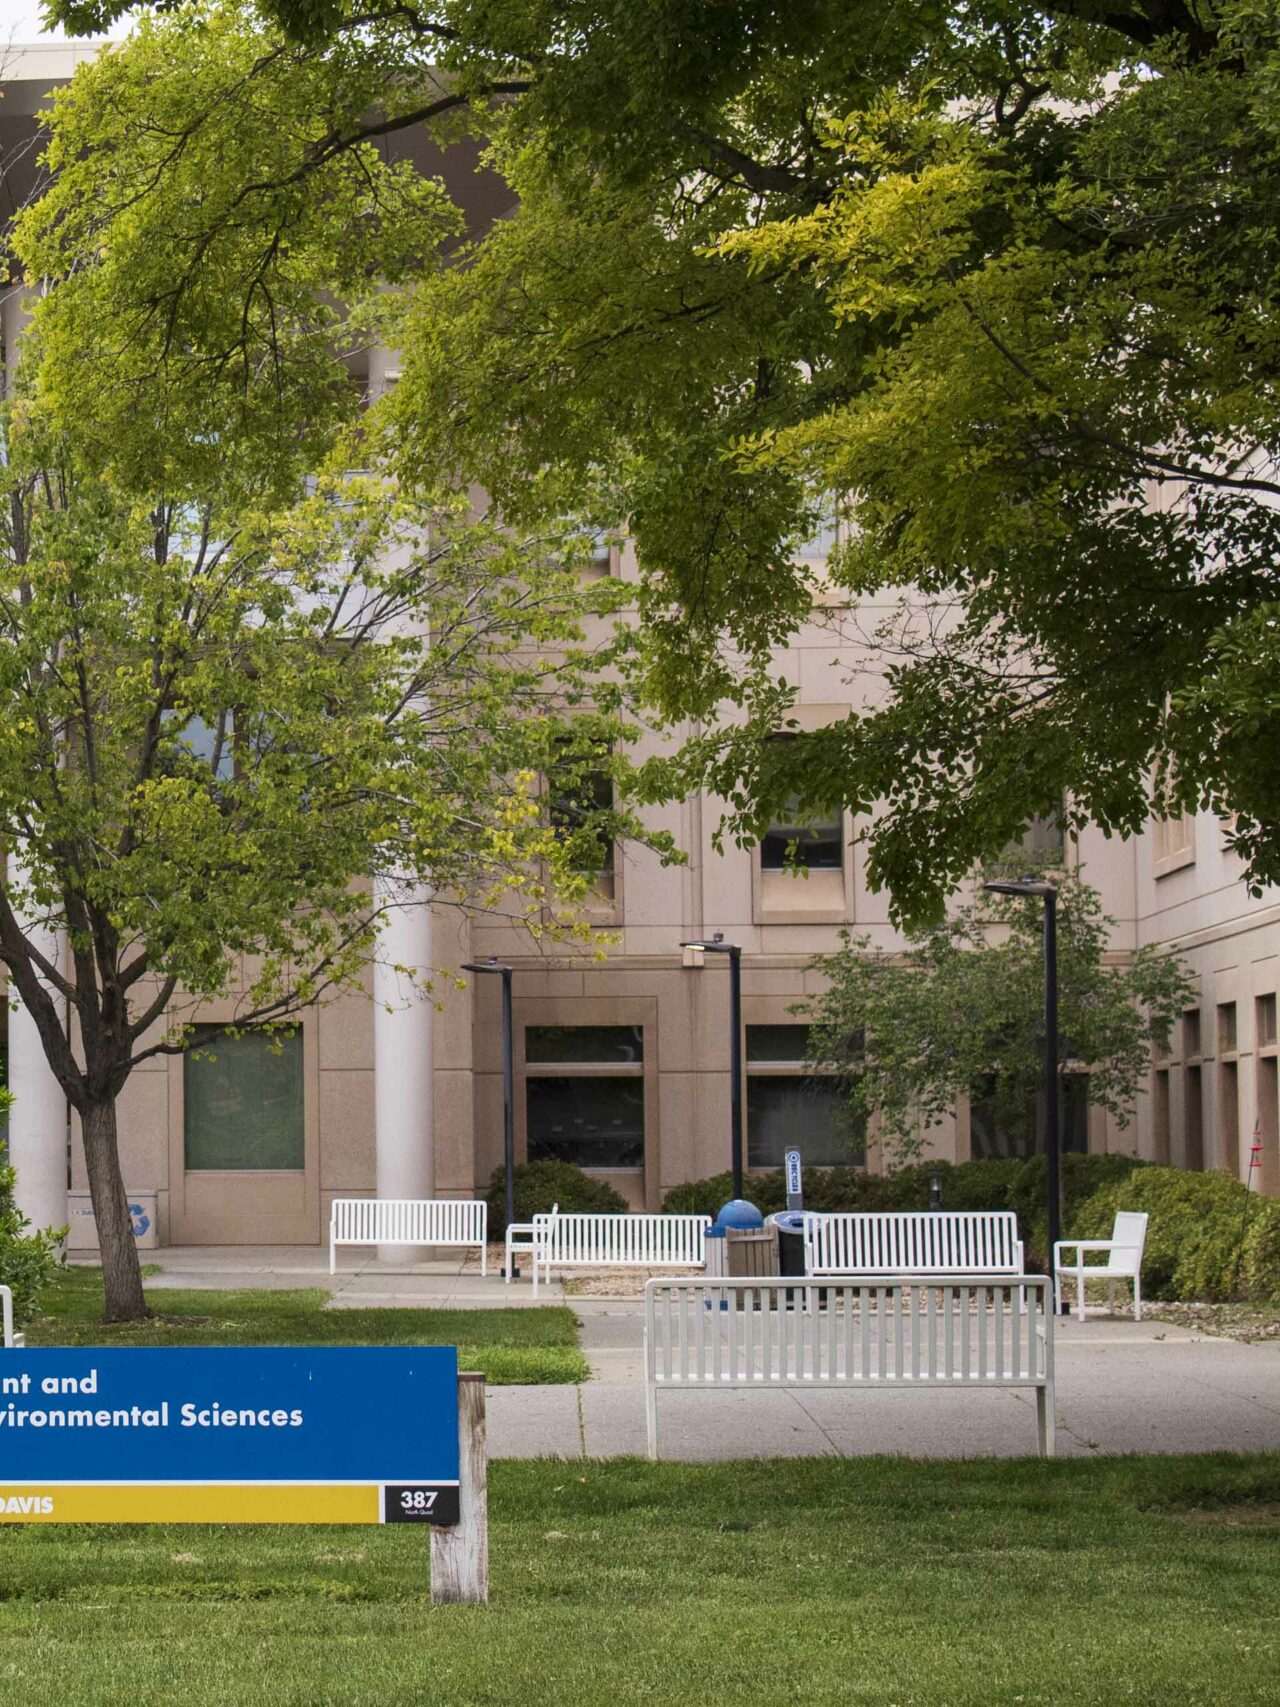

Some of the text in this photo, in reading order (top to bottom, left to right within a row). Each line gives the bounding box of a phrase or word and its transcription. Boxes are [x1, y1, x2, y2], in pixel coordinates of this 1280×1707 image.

[41, 1369, 98, 1394] and
[180, 1402, 303, 1427] Sciences
[401, 1491, 438, 1508] 387
